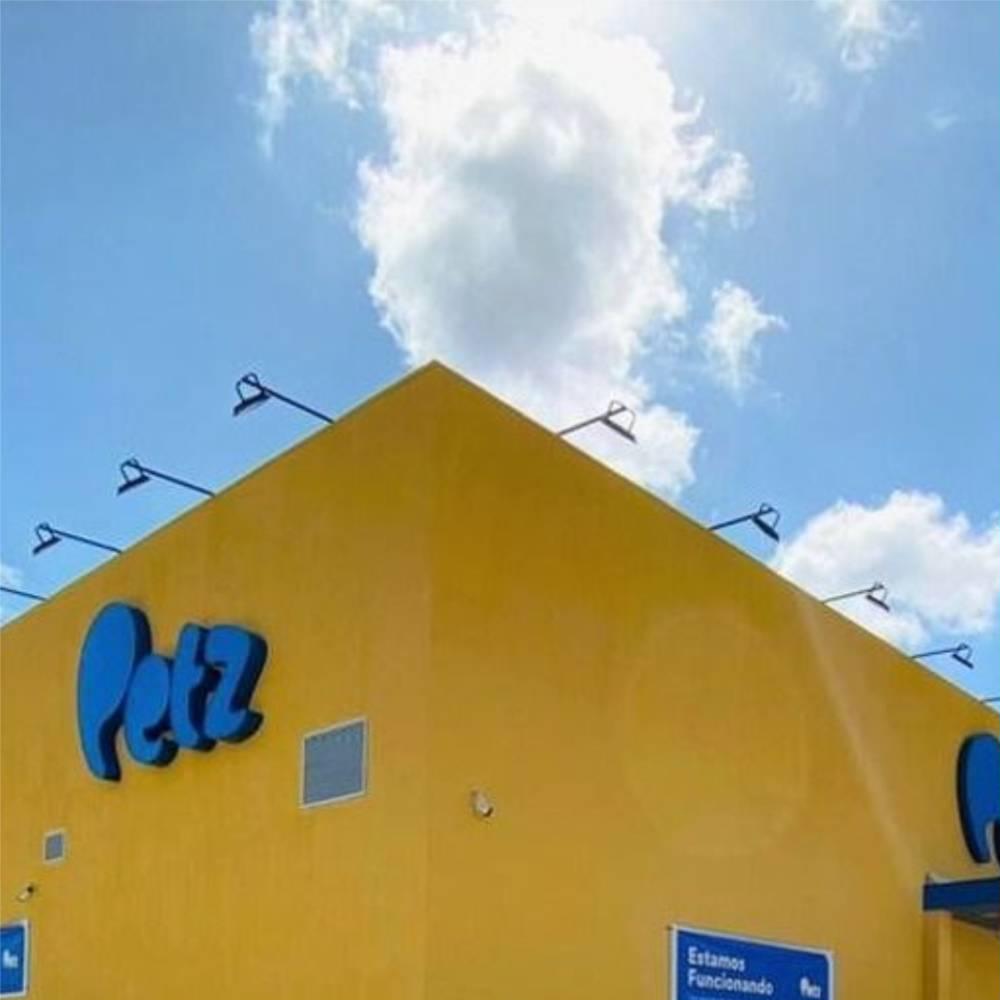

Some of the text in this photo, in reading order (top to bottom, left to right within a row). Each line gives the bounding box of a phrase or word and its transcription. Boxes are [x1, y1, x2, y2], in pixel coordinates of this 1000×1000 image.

[78, 601, 268, 782] Petz
[687, 945, 746, 973] Estamos
[687, 968, 775, 997] Funcionando
